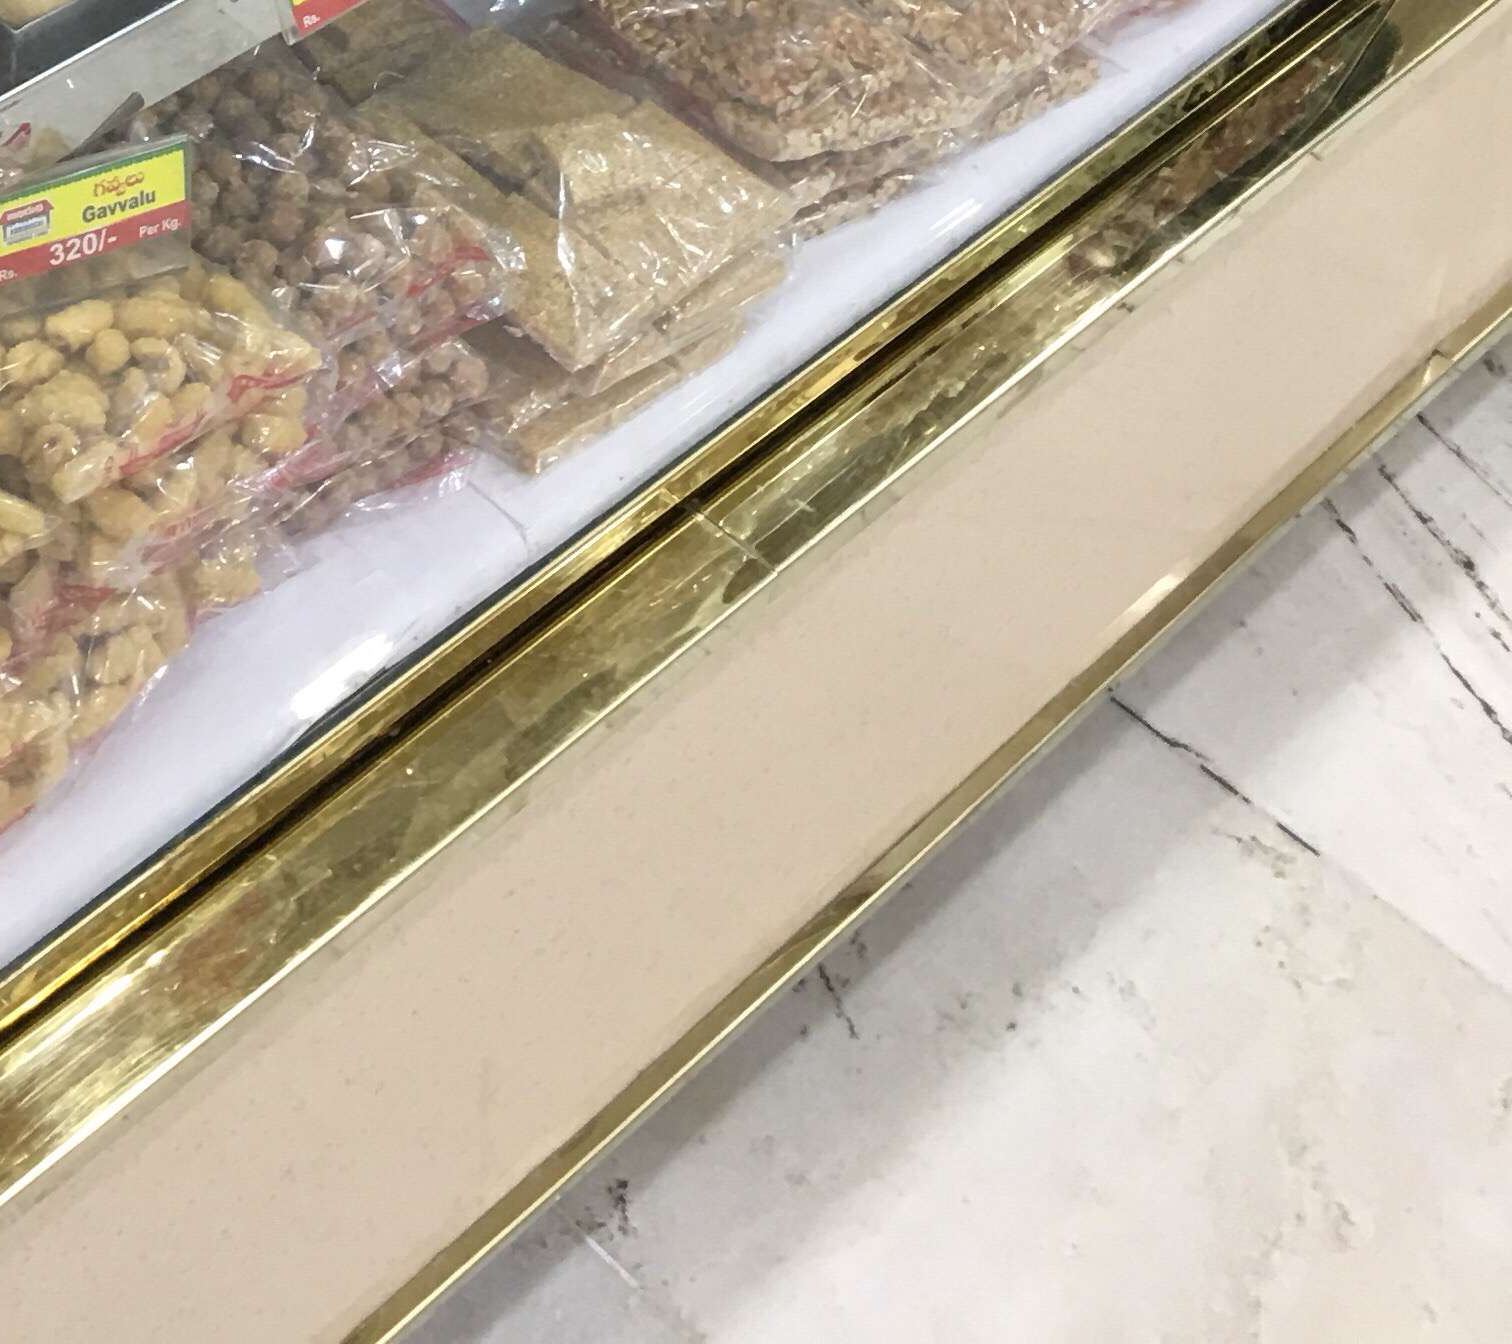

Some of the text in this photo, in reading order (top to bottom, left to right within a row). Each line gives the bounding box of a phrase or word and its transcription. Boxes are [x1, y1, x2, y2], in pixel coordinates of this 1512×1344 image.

[303, 13, 320, 28] Rs.
[82, 189, 157, 223] Gavvalu
[49, 229, 118, 266] 320/-
[139, 224, 159, 238] Per
[162, 216, 181, 231] Kg.
